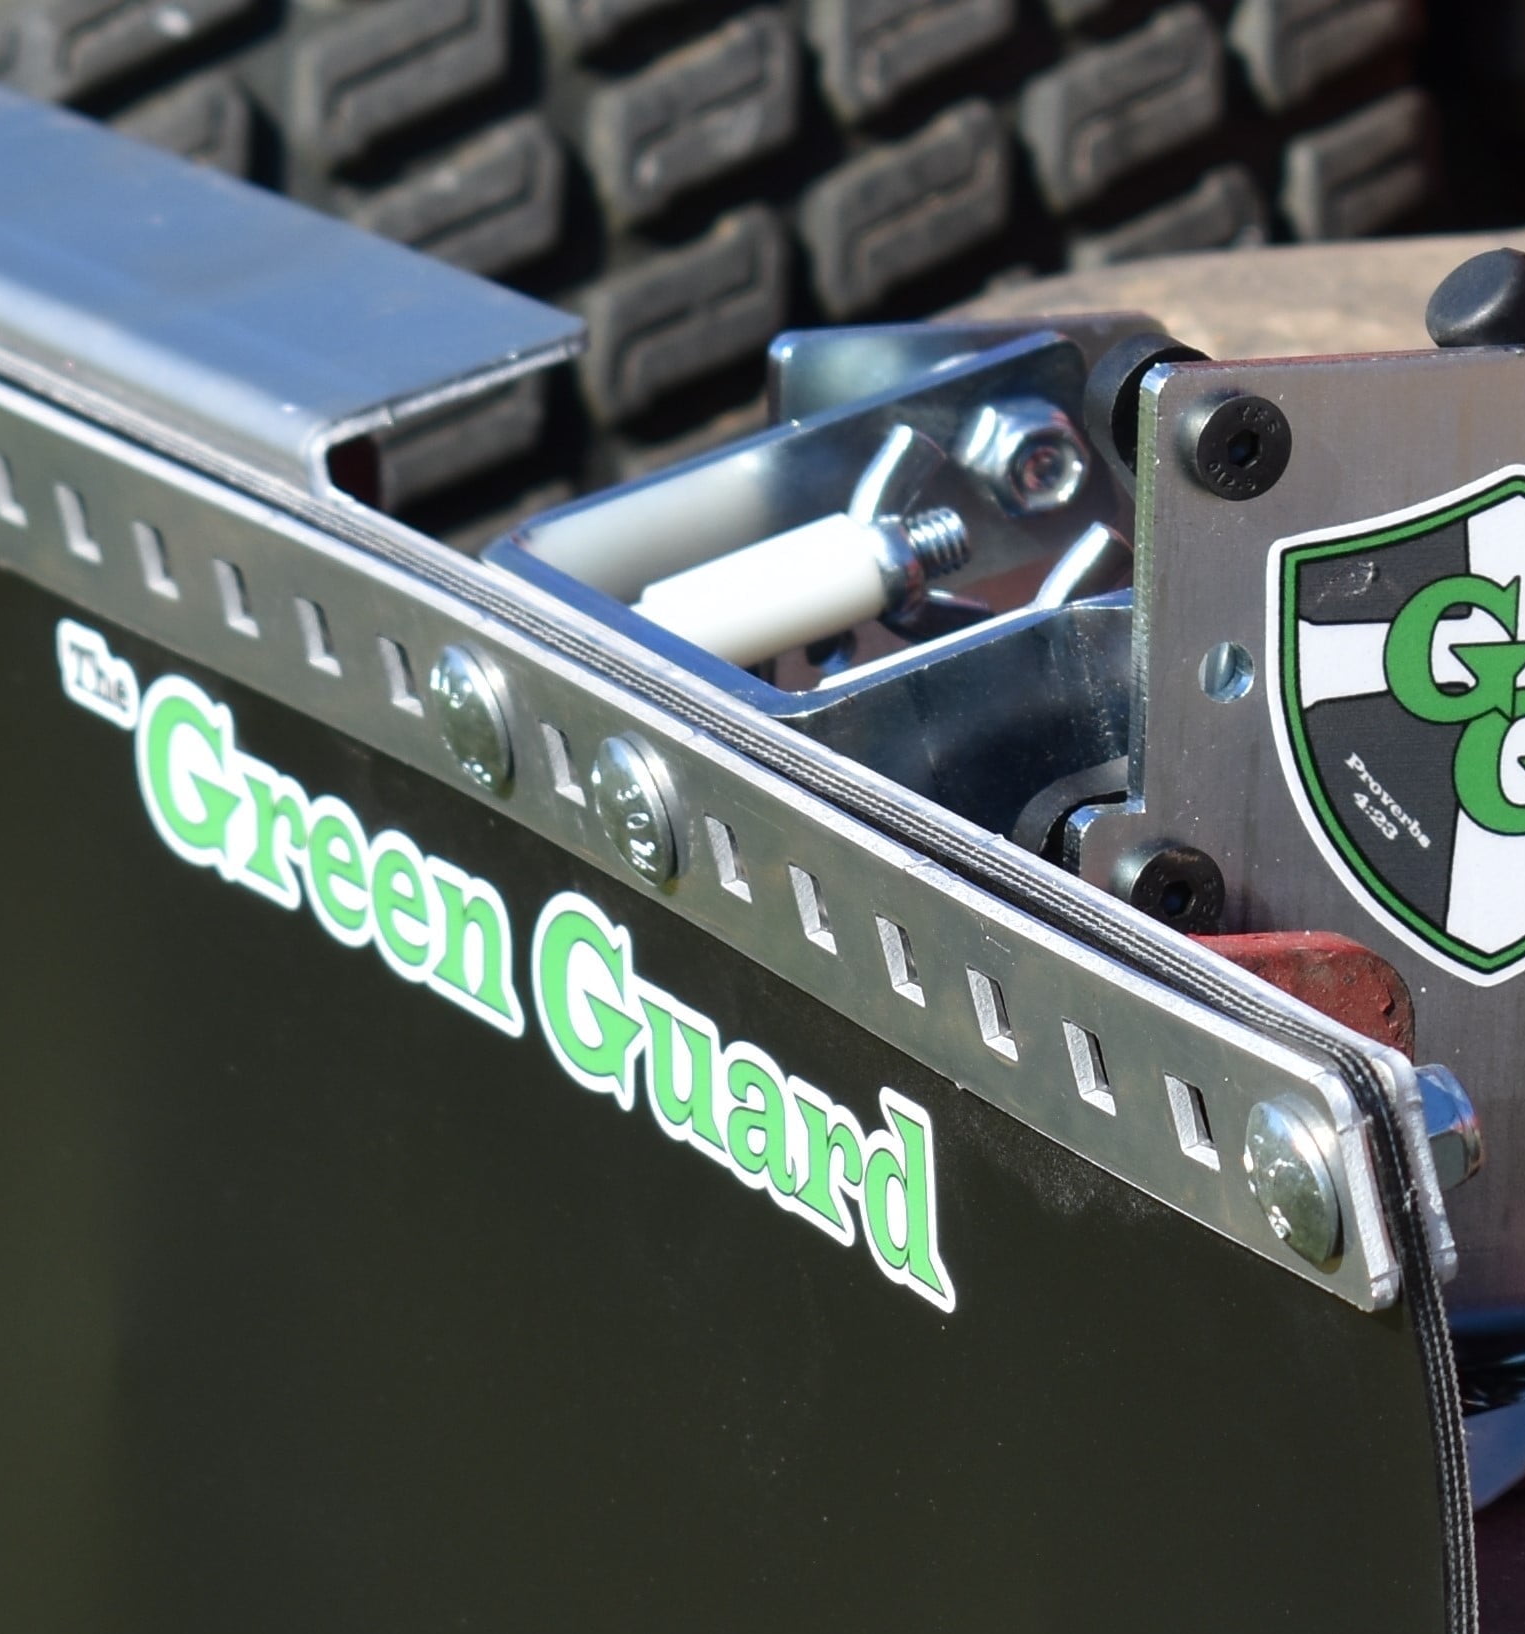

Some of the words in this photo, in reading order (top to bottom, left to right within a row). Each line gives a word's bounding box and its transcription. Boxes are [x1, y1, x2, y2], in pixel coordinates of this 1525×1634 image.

[1344, 752, 1431, 848] Proverbs
[1353, 792, 1399, 840] 4:23
[66, 636, 132, 717] The
[145, 693, 513, 1020] Green
[537, 907, 947, 1302] Guard
